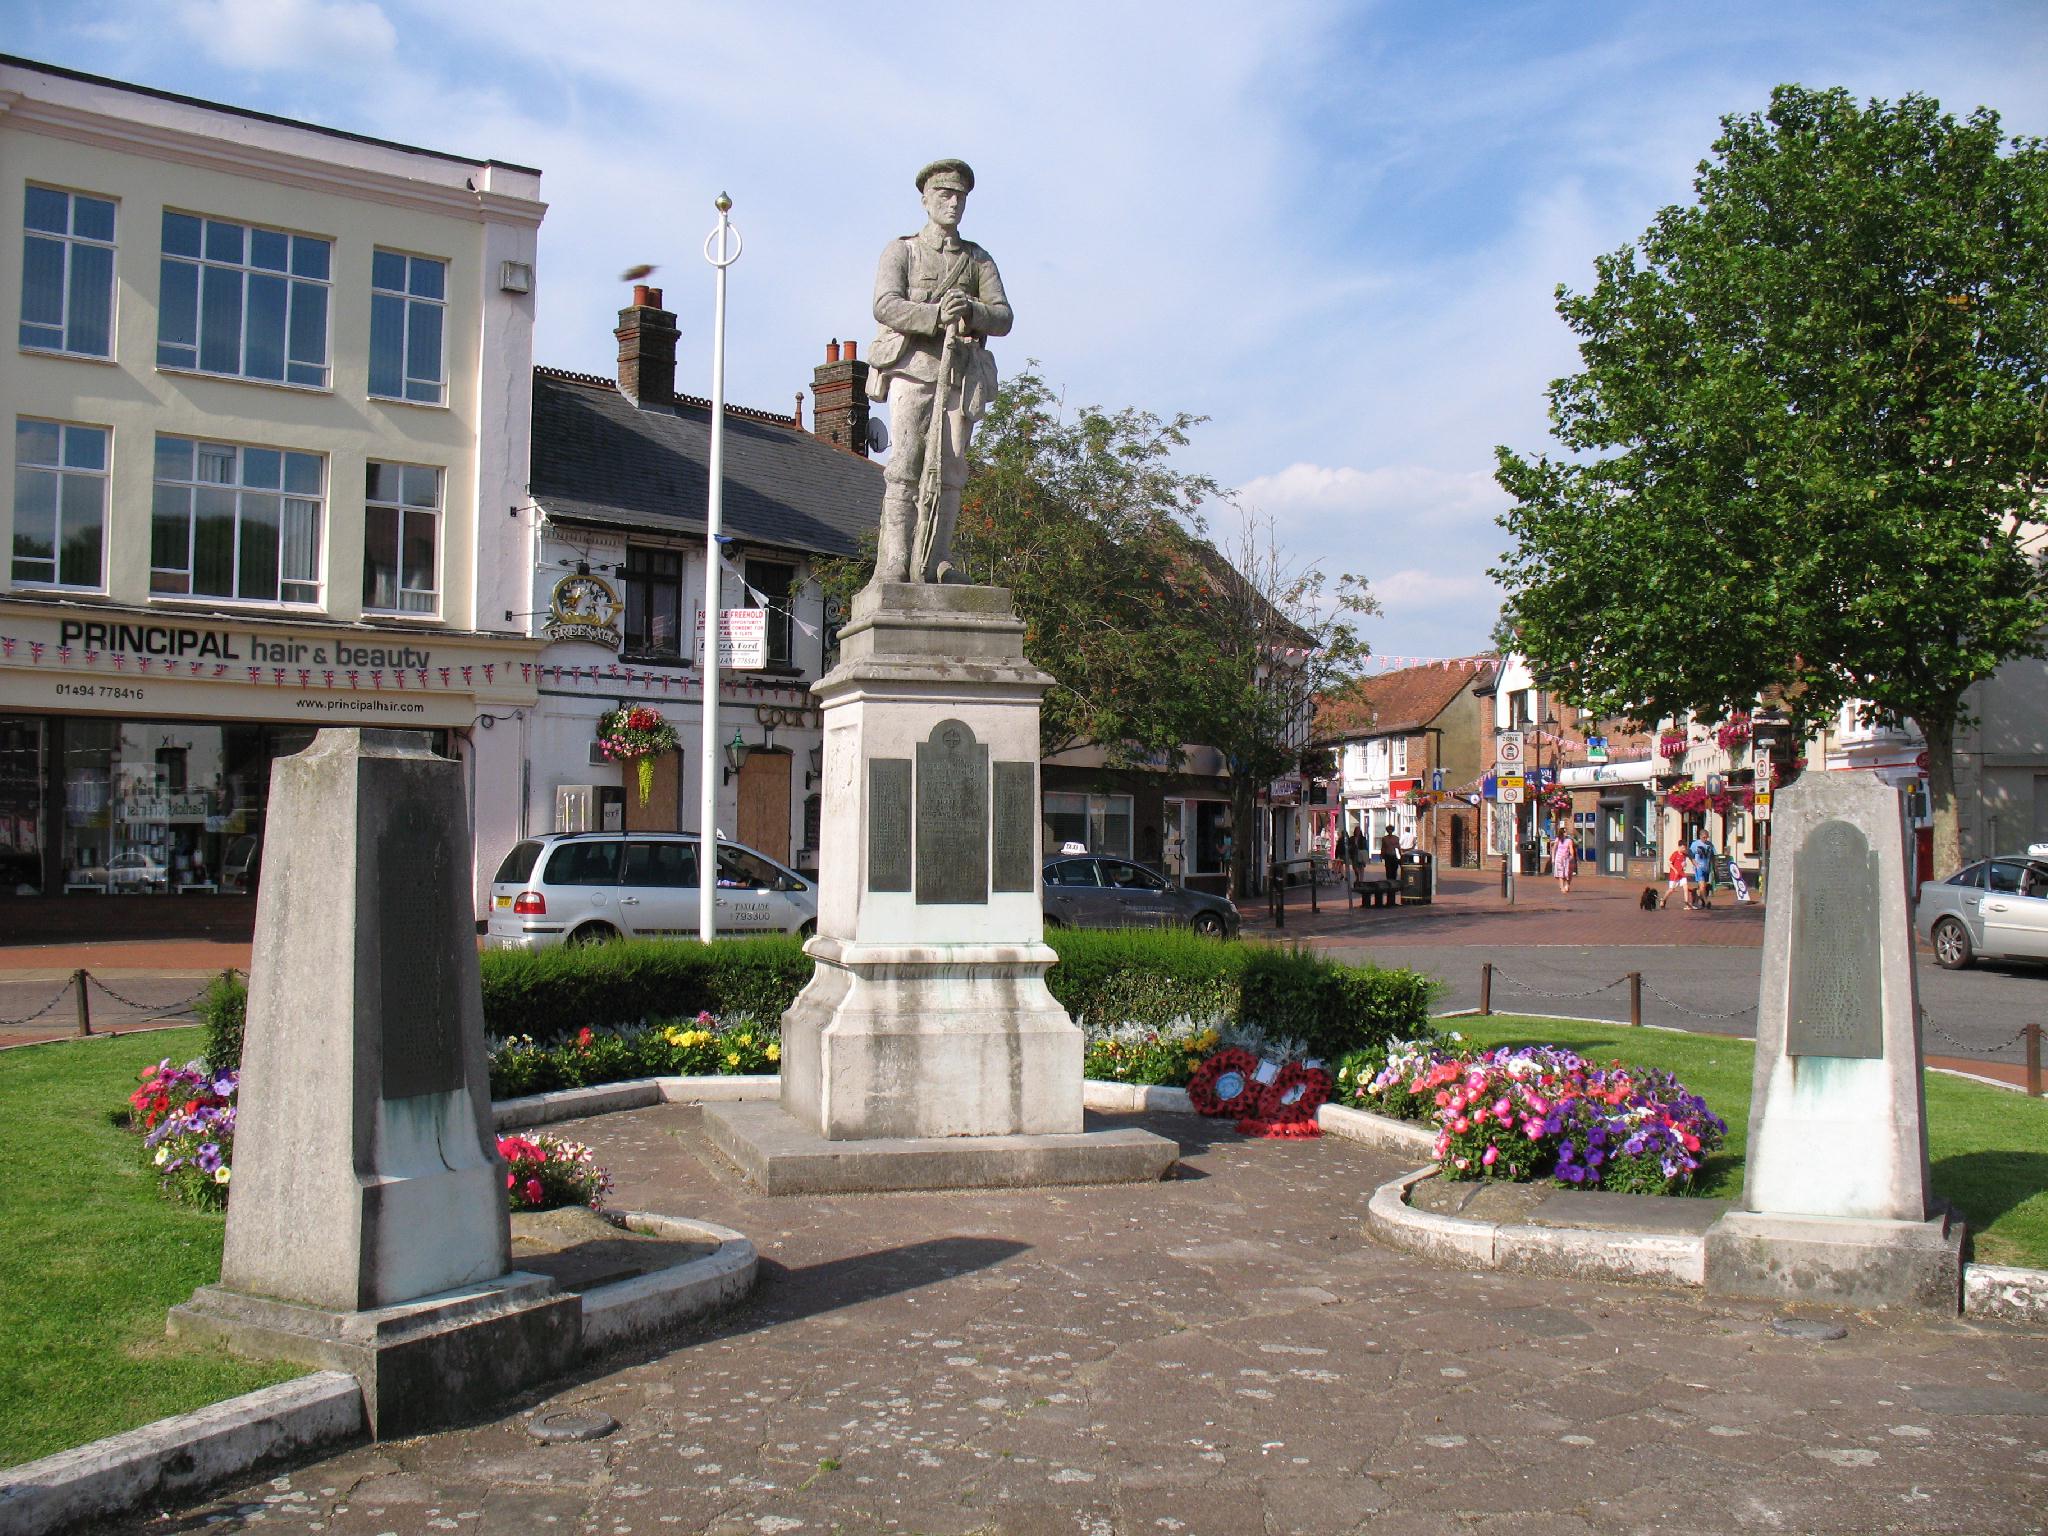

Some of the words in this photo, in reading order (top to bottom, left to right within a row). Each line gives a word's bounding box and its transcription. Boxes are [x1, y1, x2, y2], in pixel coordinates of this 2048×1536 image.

[730, 610, 763, 619] FREEHOLD
[60, 620, 240, 660] PRINCIPAL
[251, 635, 307, 664] hair
[313, 648, 328, 664] &
[56, 683, 95, 697] 01494
[98, 686, 144, 700] 778416
[296, 699, 424, 713] www.principalhair.com
[735, 912, 771, 921] 793300
